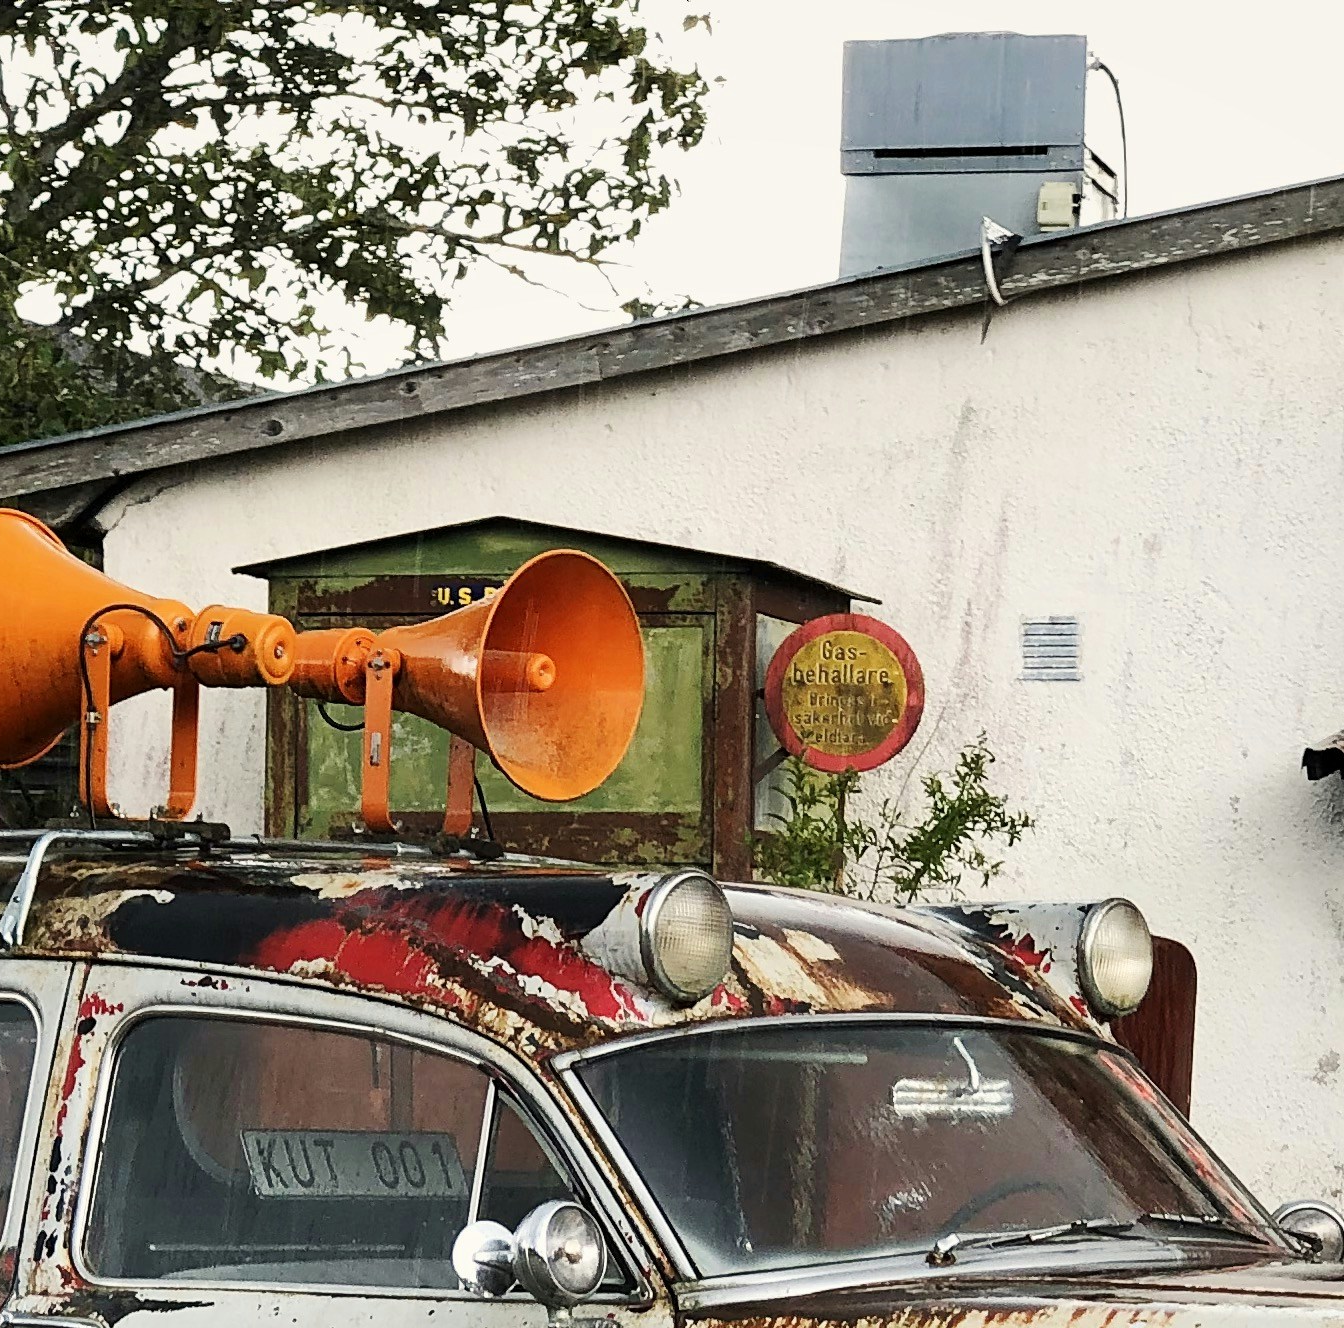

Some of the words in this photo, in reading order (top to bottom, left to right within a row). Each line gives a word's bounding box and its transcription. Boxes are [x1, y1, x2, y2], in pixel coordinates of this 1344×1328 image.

[820, 640, 867, 660] Gas-
[256, 1138, 338, 1188] KUT
[372, 1140, 453, 1189] 001
